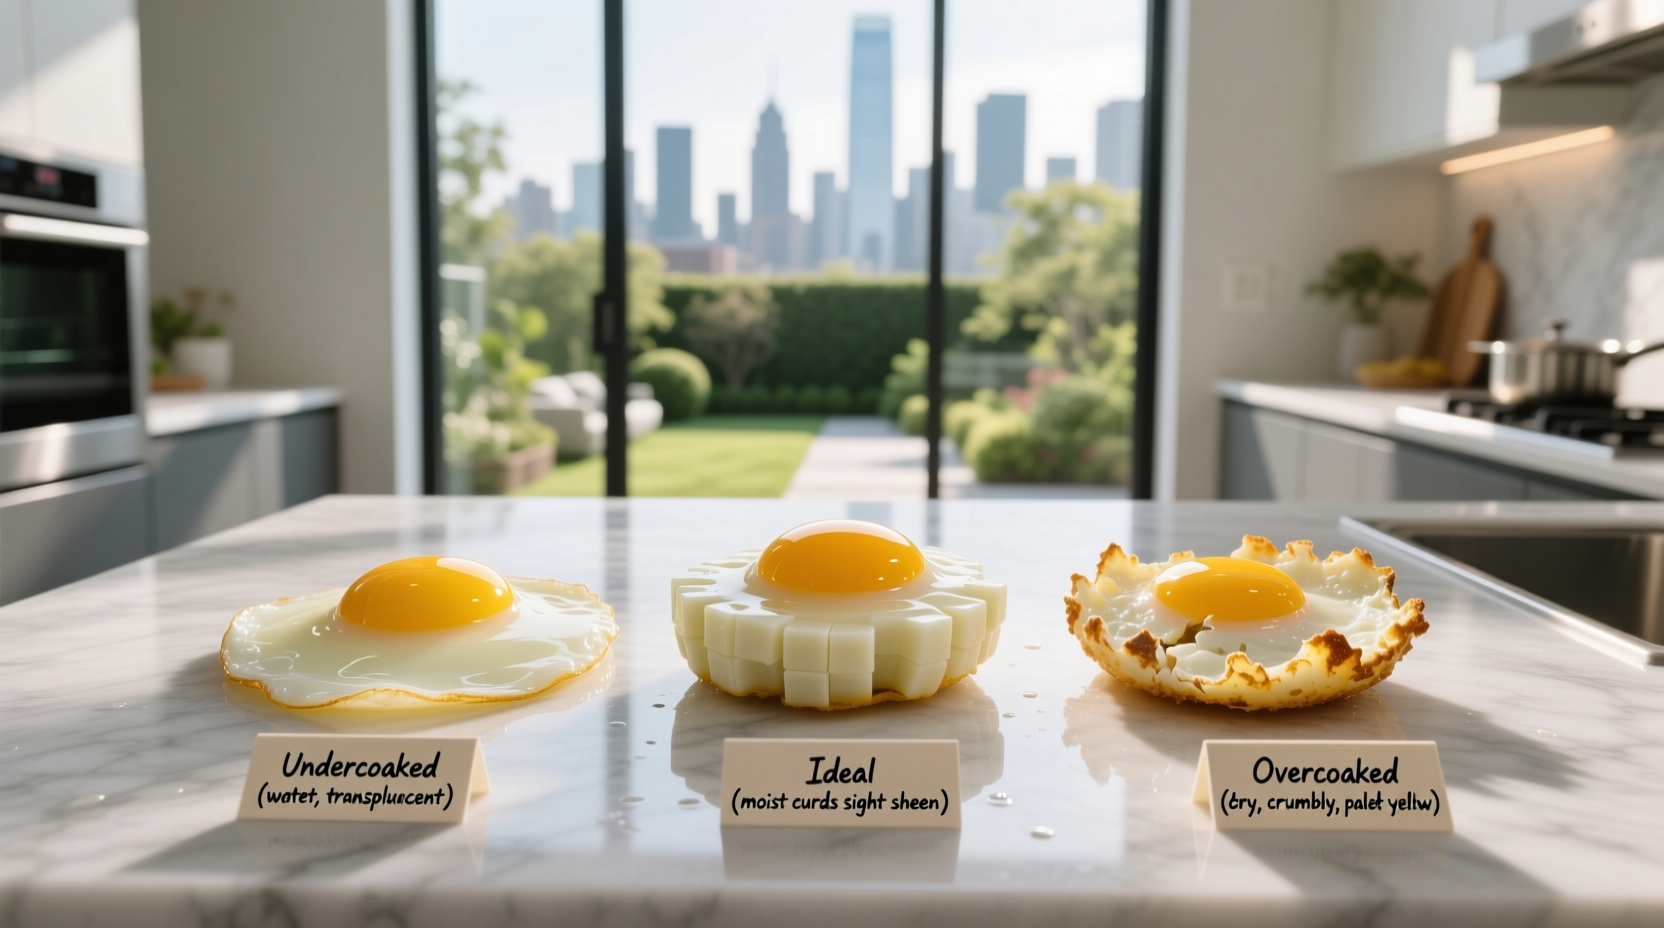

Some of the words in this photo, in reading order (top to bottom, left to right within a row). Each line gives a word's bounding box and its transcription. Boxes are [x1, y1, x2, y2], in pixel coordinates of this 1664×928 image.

[282, 749, 441, 778] Undercoaked
[805, 755, 876, 785] Ideal
[1252, 755, 1399, 785] Overcoaked
[731, 787, 788, 816] (moist
[791, 790, 839, 810] curds
[843, 791, 887, 817] sight
[890, 788, 949, 816] sheen)
[1267, 790, 1340, 817] crumbly,
